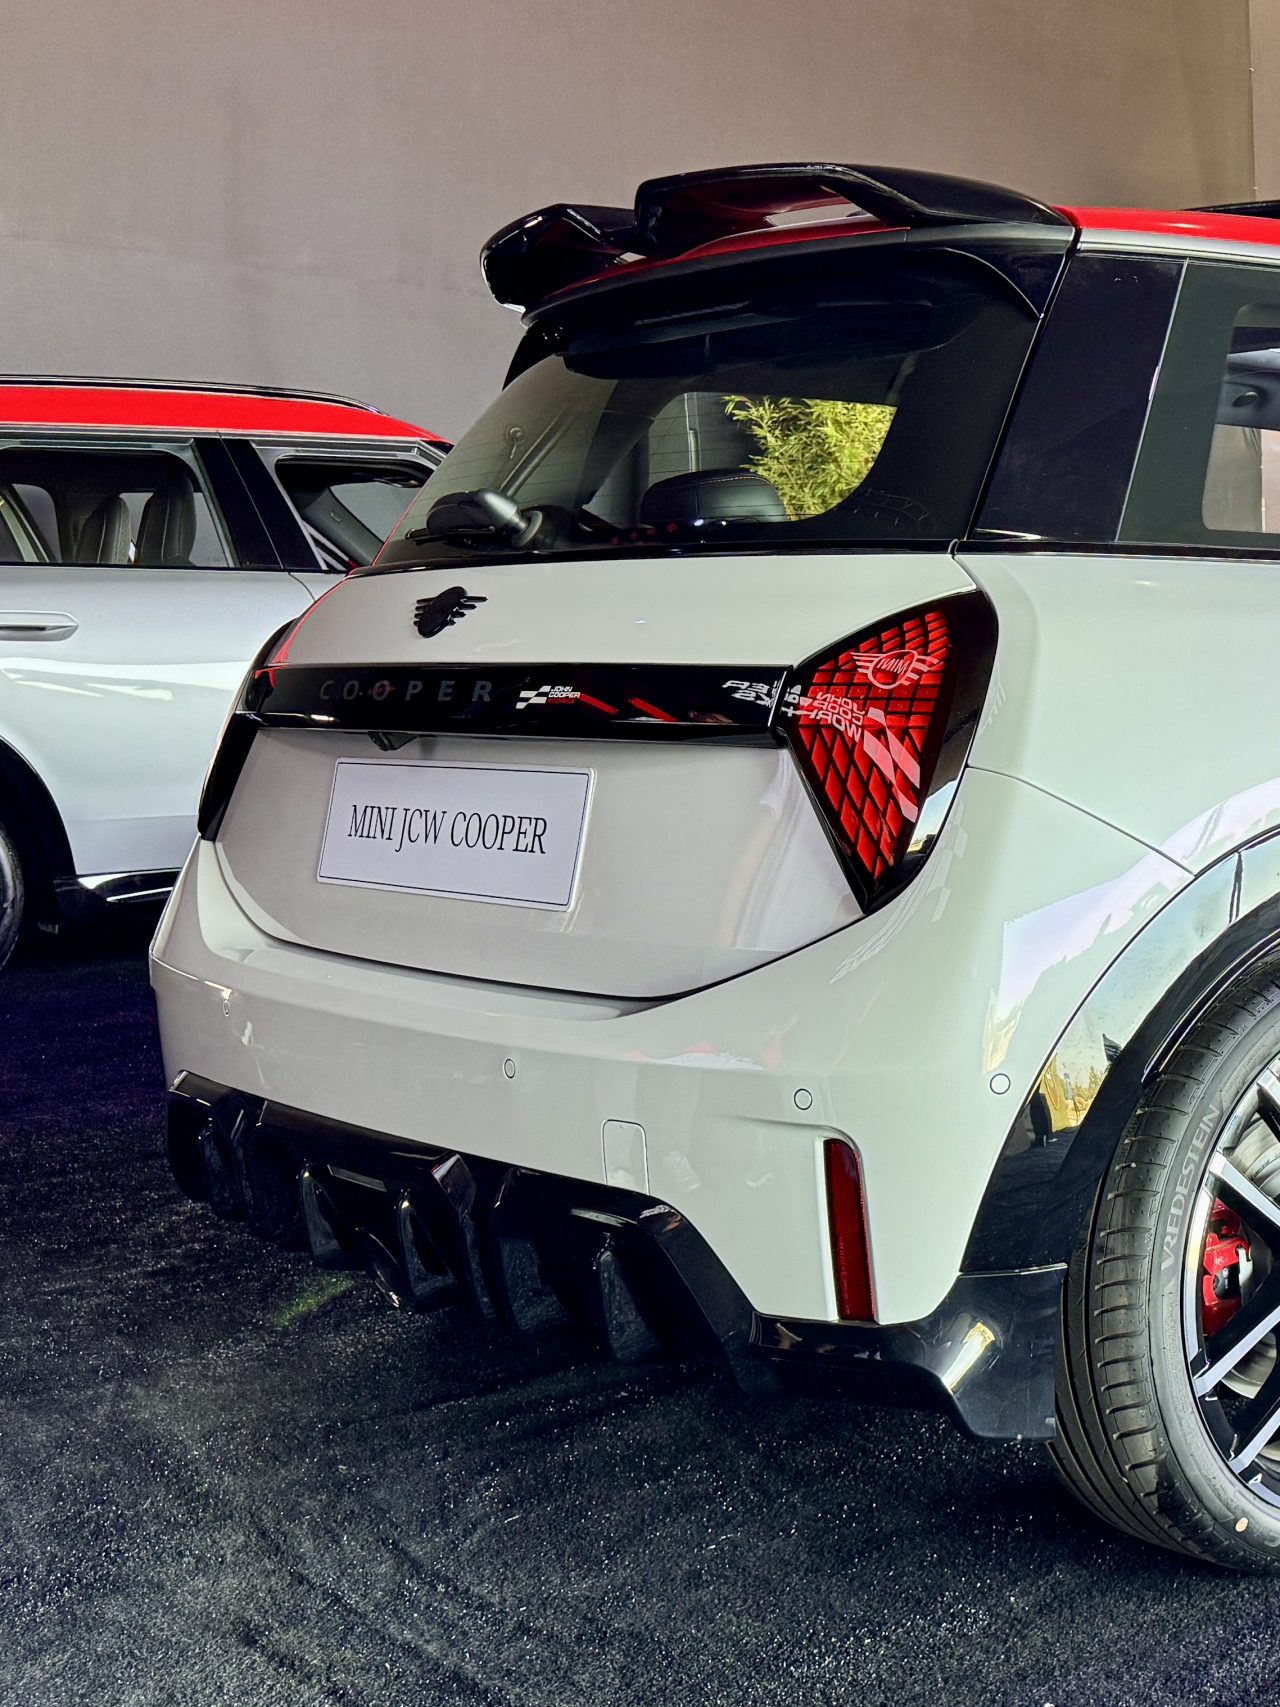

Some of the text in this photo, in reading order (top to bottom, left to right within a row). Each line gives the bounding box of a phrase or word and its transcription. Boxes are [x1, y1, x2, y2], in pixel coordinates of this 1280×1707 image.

[319, 679, 493, 703] COOPER
[548, 691, 581, 699] COOPER
[347, 804, 548, 854] MINI JCW COOPER
[1160, 1103, 1221, 1271] VREDESTEIN
